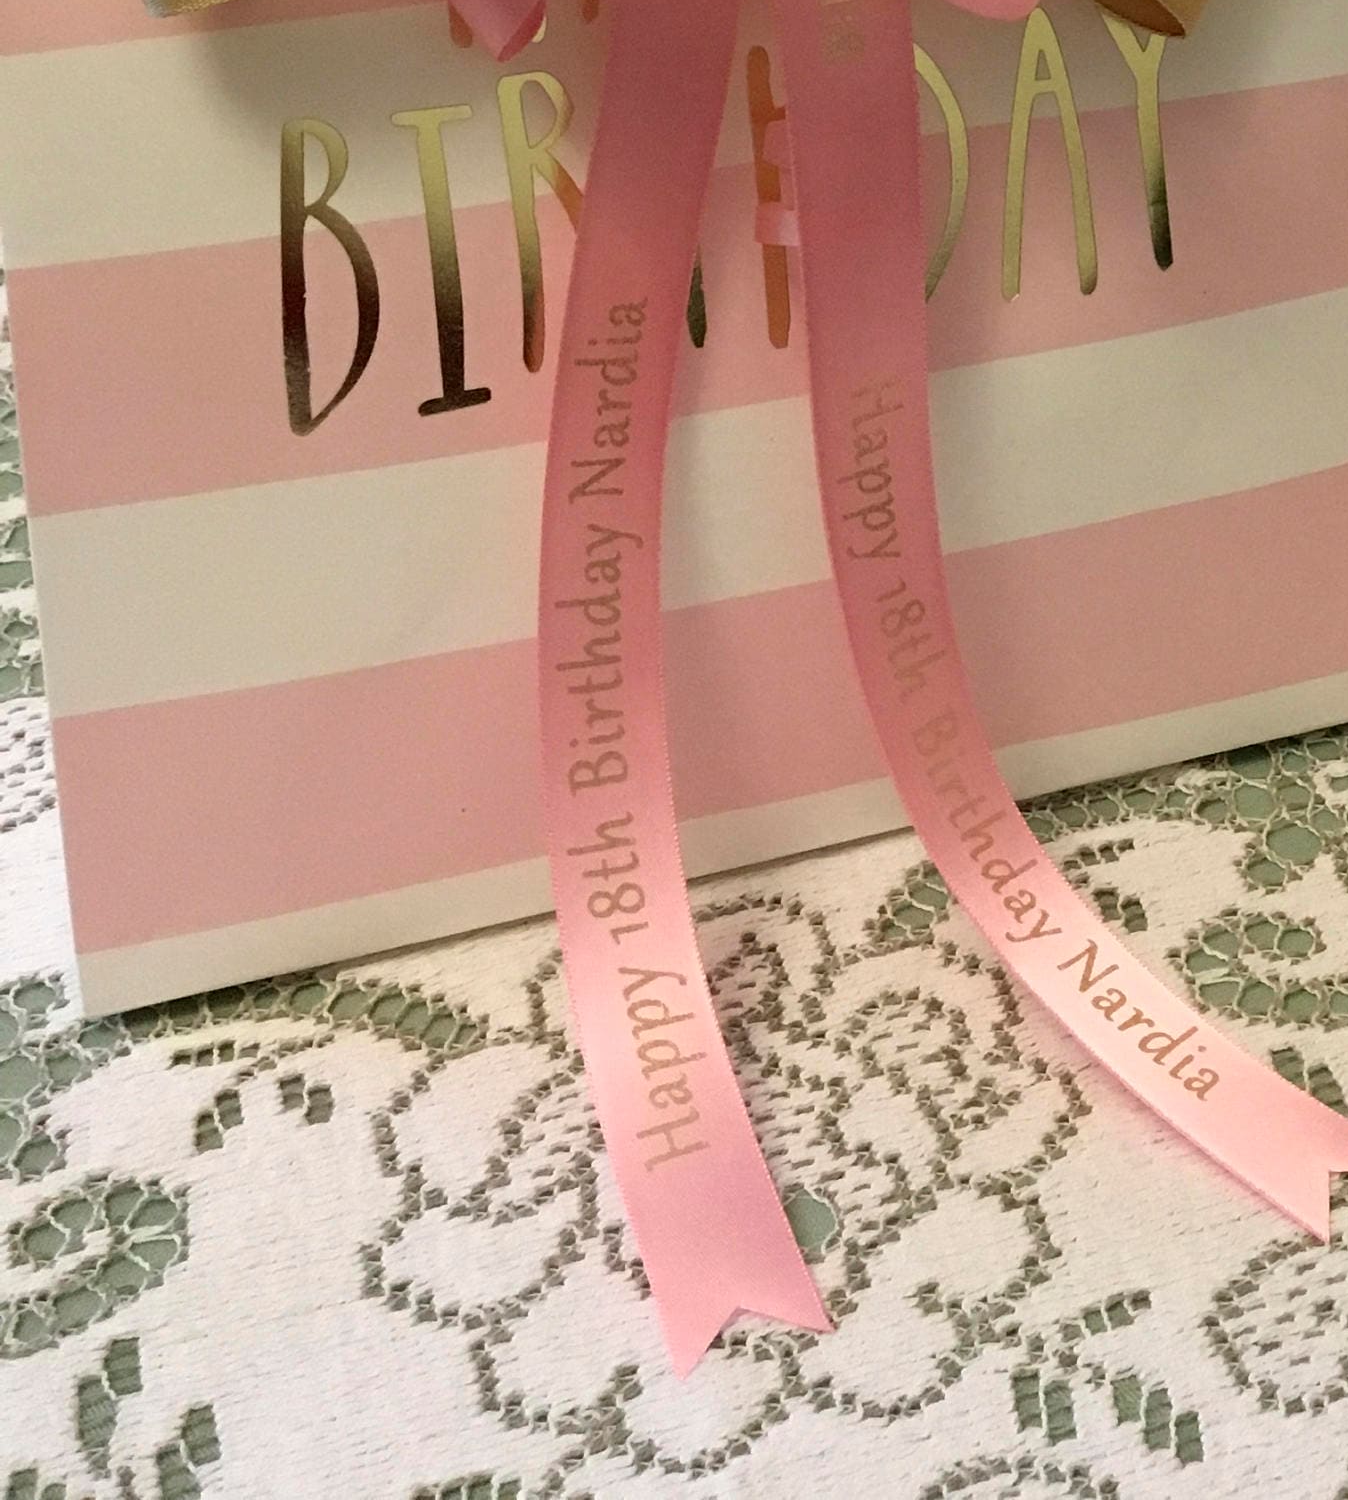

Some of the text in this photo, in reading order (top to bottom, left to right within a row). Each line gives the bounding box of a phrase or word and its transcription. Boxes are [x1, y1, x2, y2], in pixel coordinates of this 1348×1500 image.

[555, 297, 710, 1173] Happy 18th Birthday Nardia
[837, 377, 1221, 1103] Happy 18th Birthday Nardia
